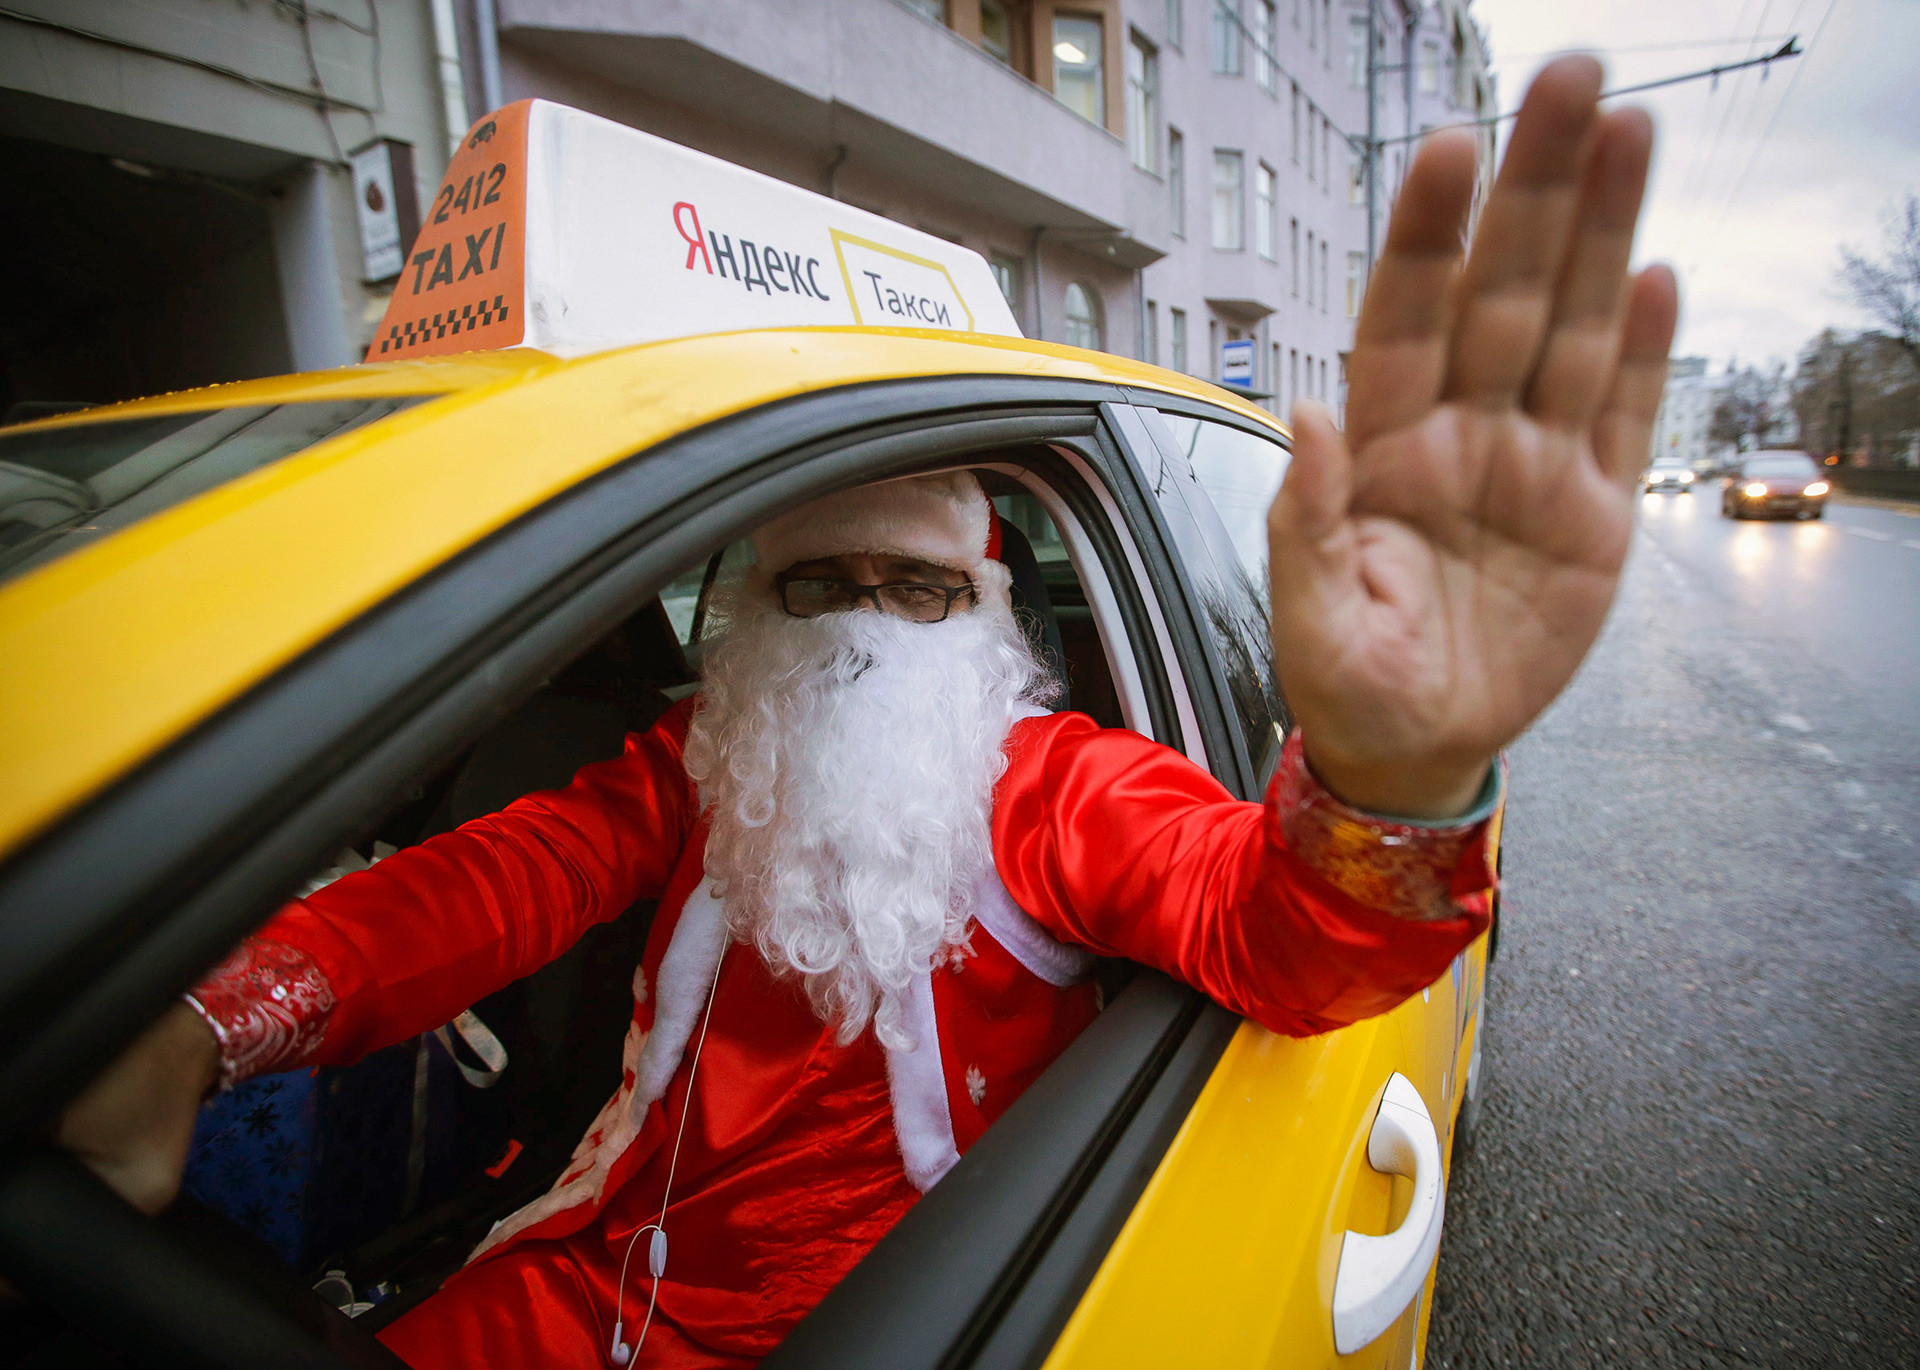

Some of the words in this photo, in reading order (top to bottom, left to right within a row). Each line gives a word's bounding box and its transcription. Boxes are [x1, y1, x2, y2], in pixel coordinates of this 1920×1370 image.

[433, 162, 507, 225] 2412
[412, 222, 506, 295] TAXI
[672, 201, 830, 301] Яндекс
[863, 270, 951, 327] Такси
